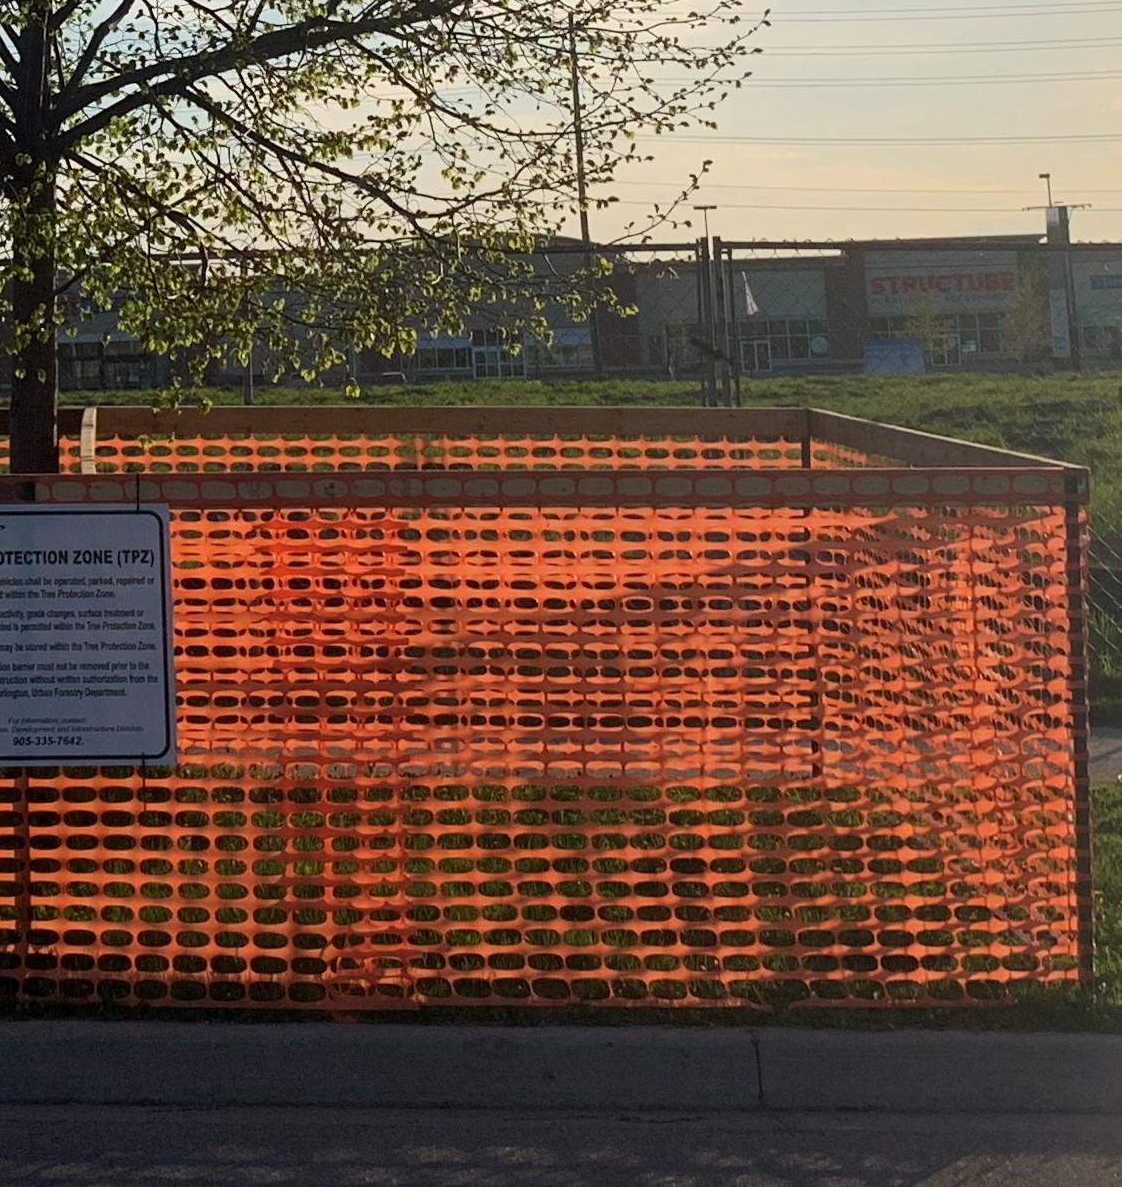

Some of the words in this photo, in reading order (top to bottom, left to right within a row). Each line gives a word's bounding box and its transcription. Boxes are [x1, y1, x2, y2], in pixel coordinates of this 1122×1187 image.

[871, 272, 1015, 294] STRUCTUBE
[73, 550, 113, 565] ZONE
[118, 550, 155, 568] (TPZ)
[116, 578, 145, 586] repaired
[5, 591, 26, 599] within
[96, 590, 116, 598] Zone.
[27, 610, 45, 619] grade
[13, 623, 19, 631] is
[20, 623, 52, 632] permitted
[53, 623, 73, 631] within
[138, 622, 156, 630] Zone.
[0, 645, 13, 653] may
[14, 643, 24, 651] be
[25, 643, 48, 651] stored
[49, 643, 70, 651] within
[101, 642, 137, 650] Protection
[138, 642, 156, 650] Zone.
[12, 663, 35, 671] barrier
[37, 663, 55, 671] must
[56, 663, 68, 671] not
[111, 662, 128, 672] prior
[130, 662, 137, 670] to
[138, 662, 149, 670] the
[30, 676, 56, 684] without
[57, 676, 81, 684] written
[32, 689, 53, 697] Urban
[54, 689, 84, 698] Forestry
